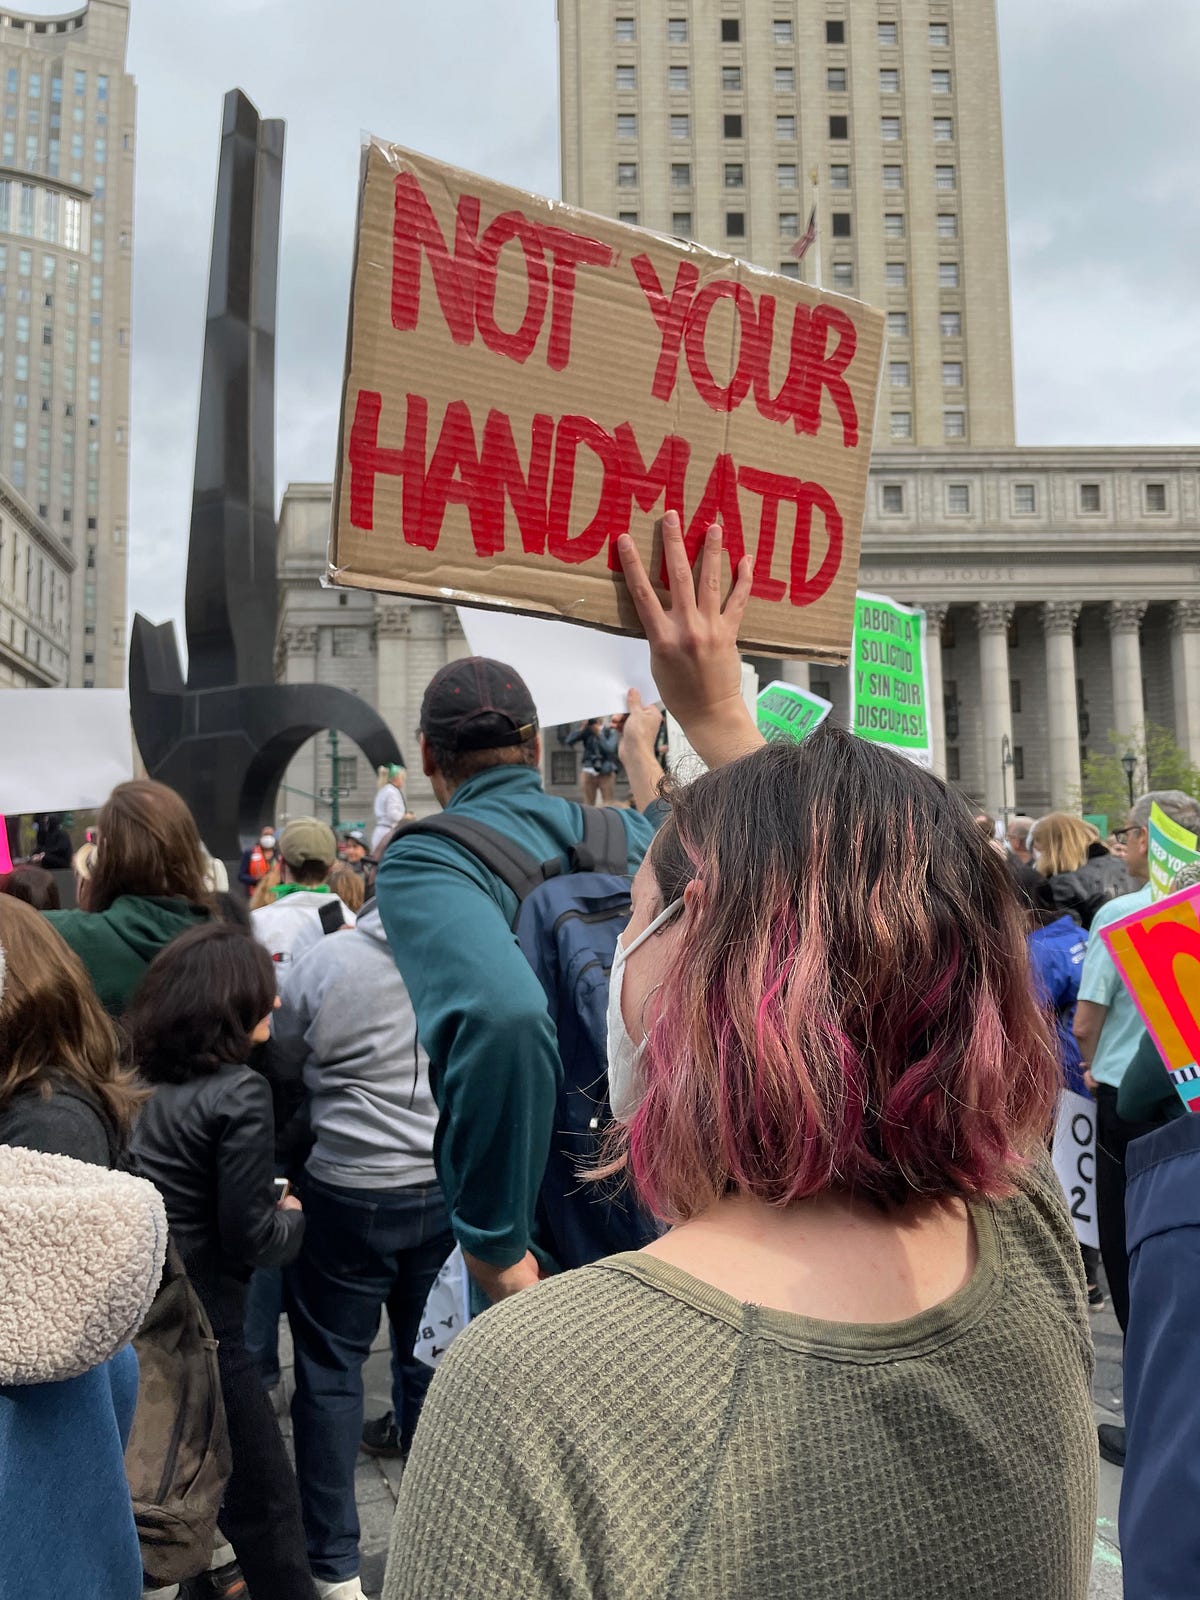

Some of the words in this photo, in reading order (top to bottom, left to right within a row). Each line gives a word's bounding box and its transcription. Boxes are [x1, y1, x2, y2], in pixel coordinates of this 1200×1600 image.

[392, 171, 620, 372] NOT
[631, 254, 859, 447] YOUR
[350, 390, 842, 606] HANDMAID
[863, 568, 921, 582] OURT
[944, 567, 1015, 582] HOUSE
[857, 671, 864, 694] Y
[869, 673, 891, 698] SIN
